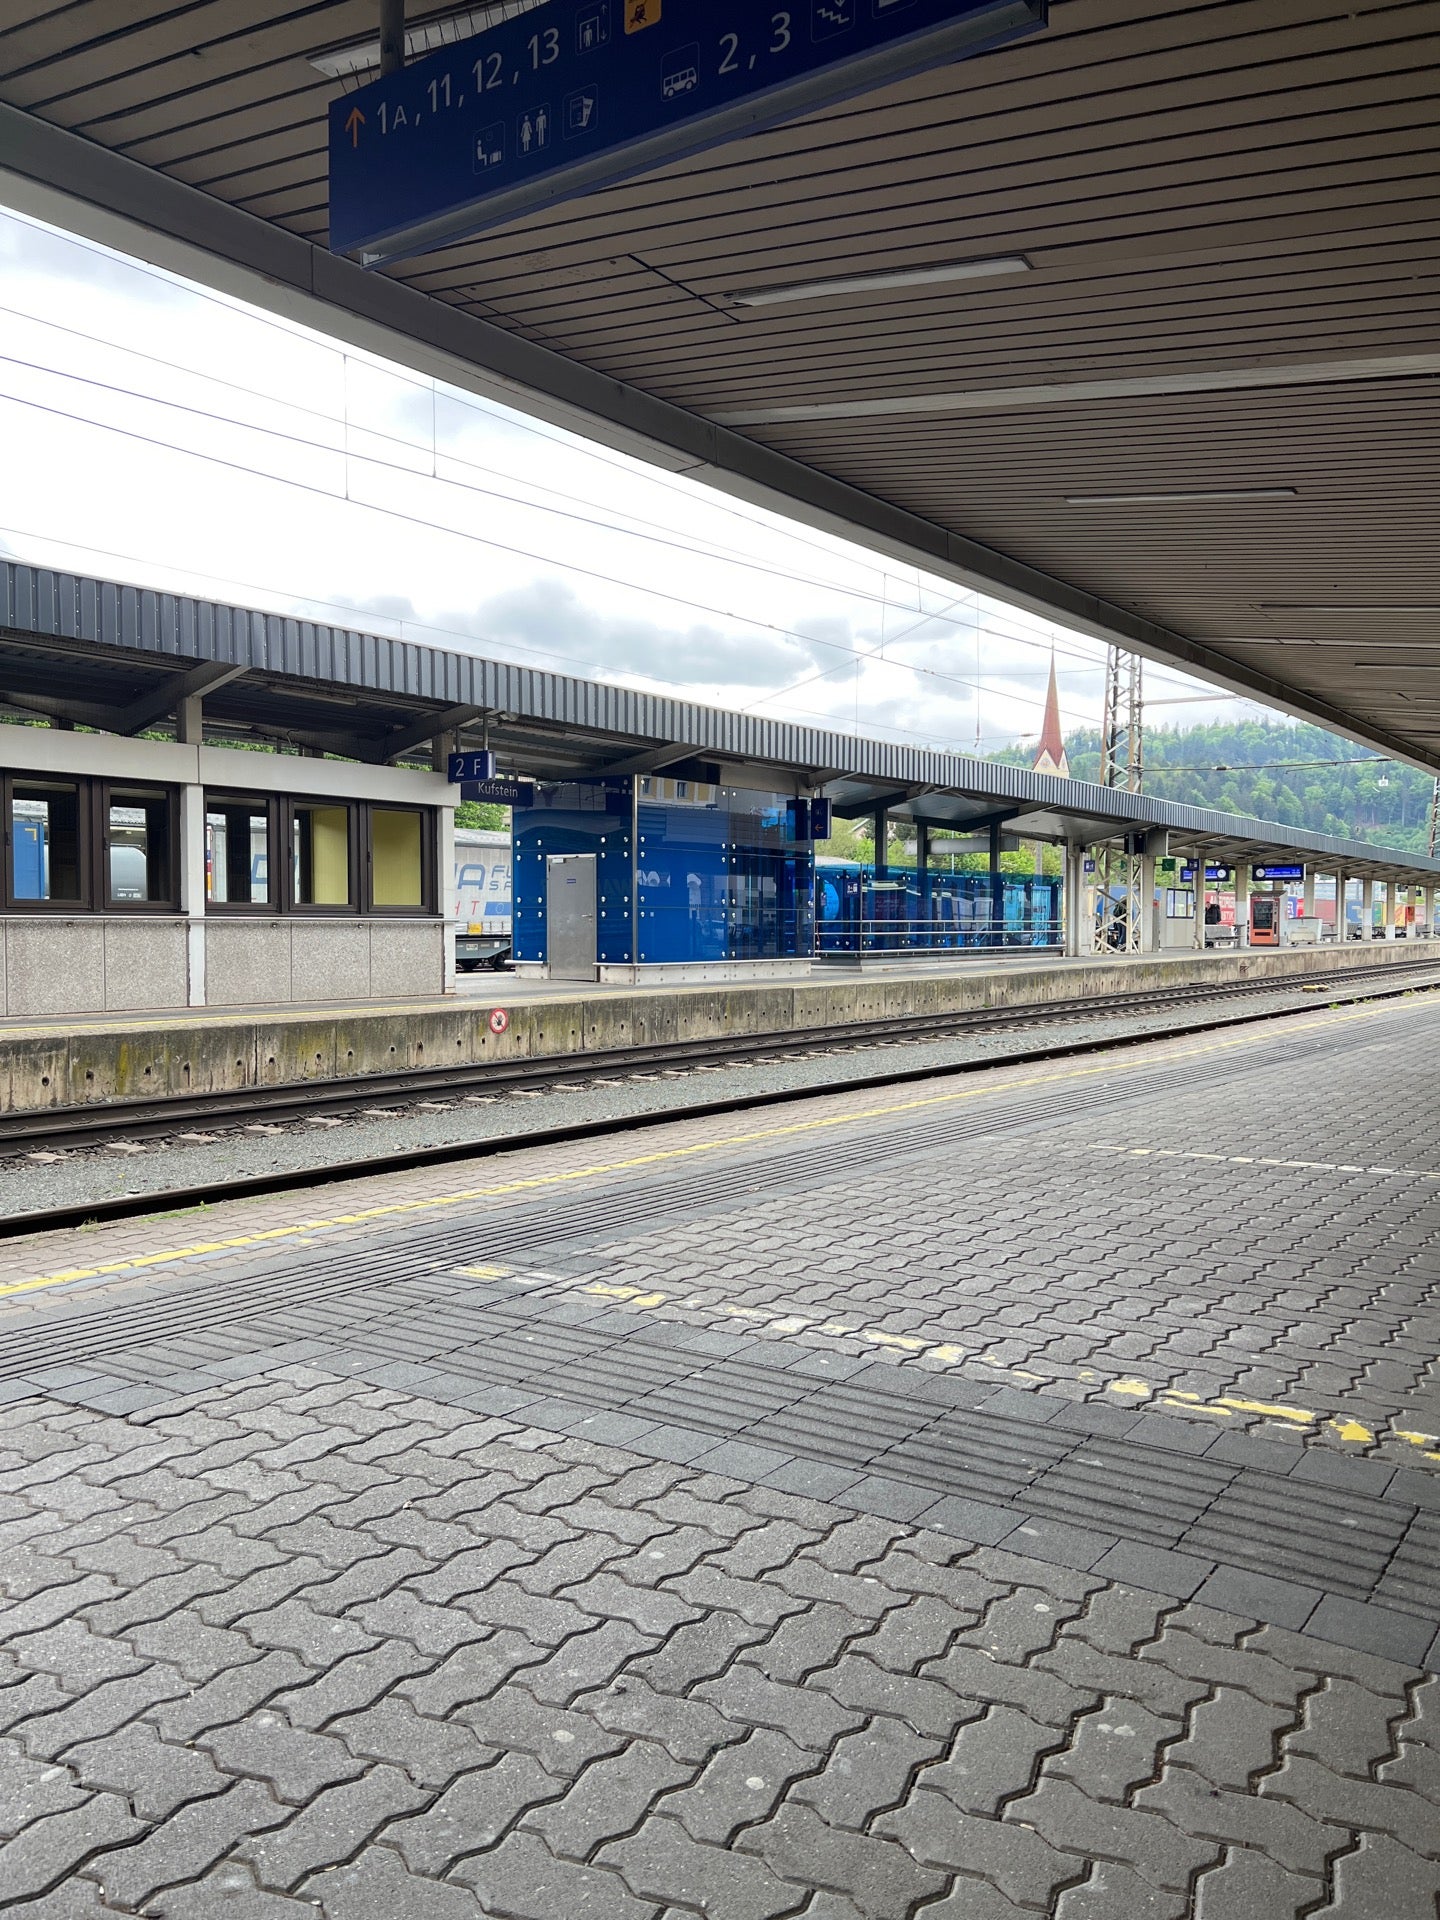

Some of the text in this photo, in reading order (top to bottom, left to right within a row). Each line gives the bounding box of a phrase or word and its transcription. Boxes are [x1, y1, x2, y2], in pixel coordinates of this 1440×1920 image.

[769, 11, 792, 53] 3
[377, 101, 421, 135] 1A,
[427, 73, 464, 113] 11,
[527, 27, 560, 70] 13
[455, 758, 481, 777] 2 F
[478, 782, 519, 798] Kufstein
